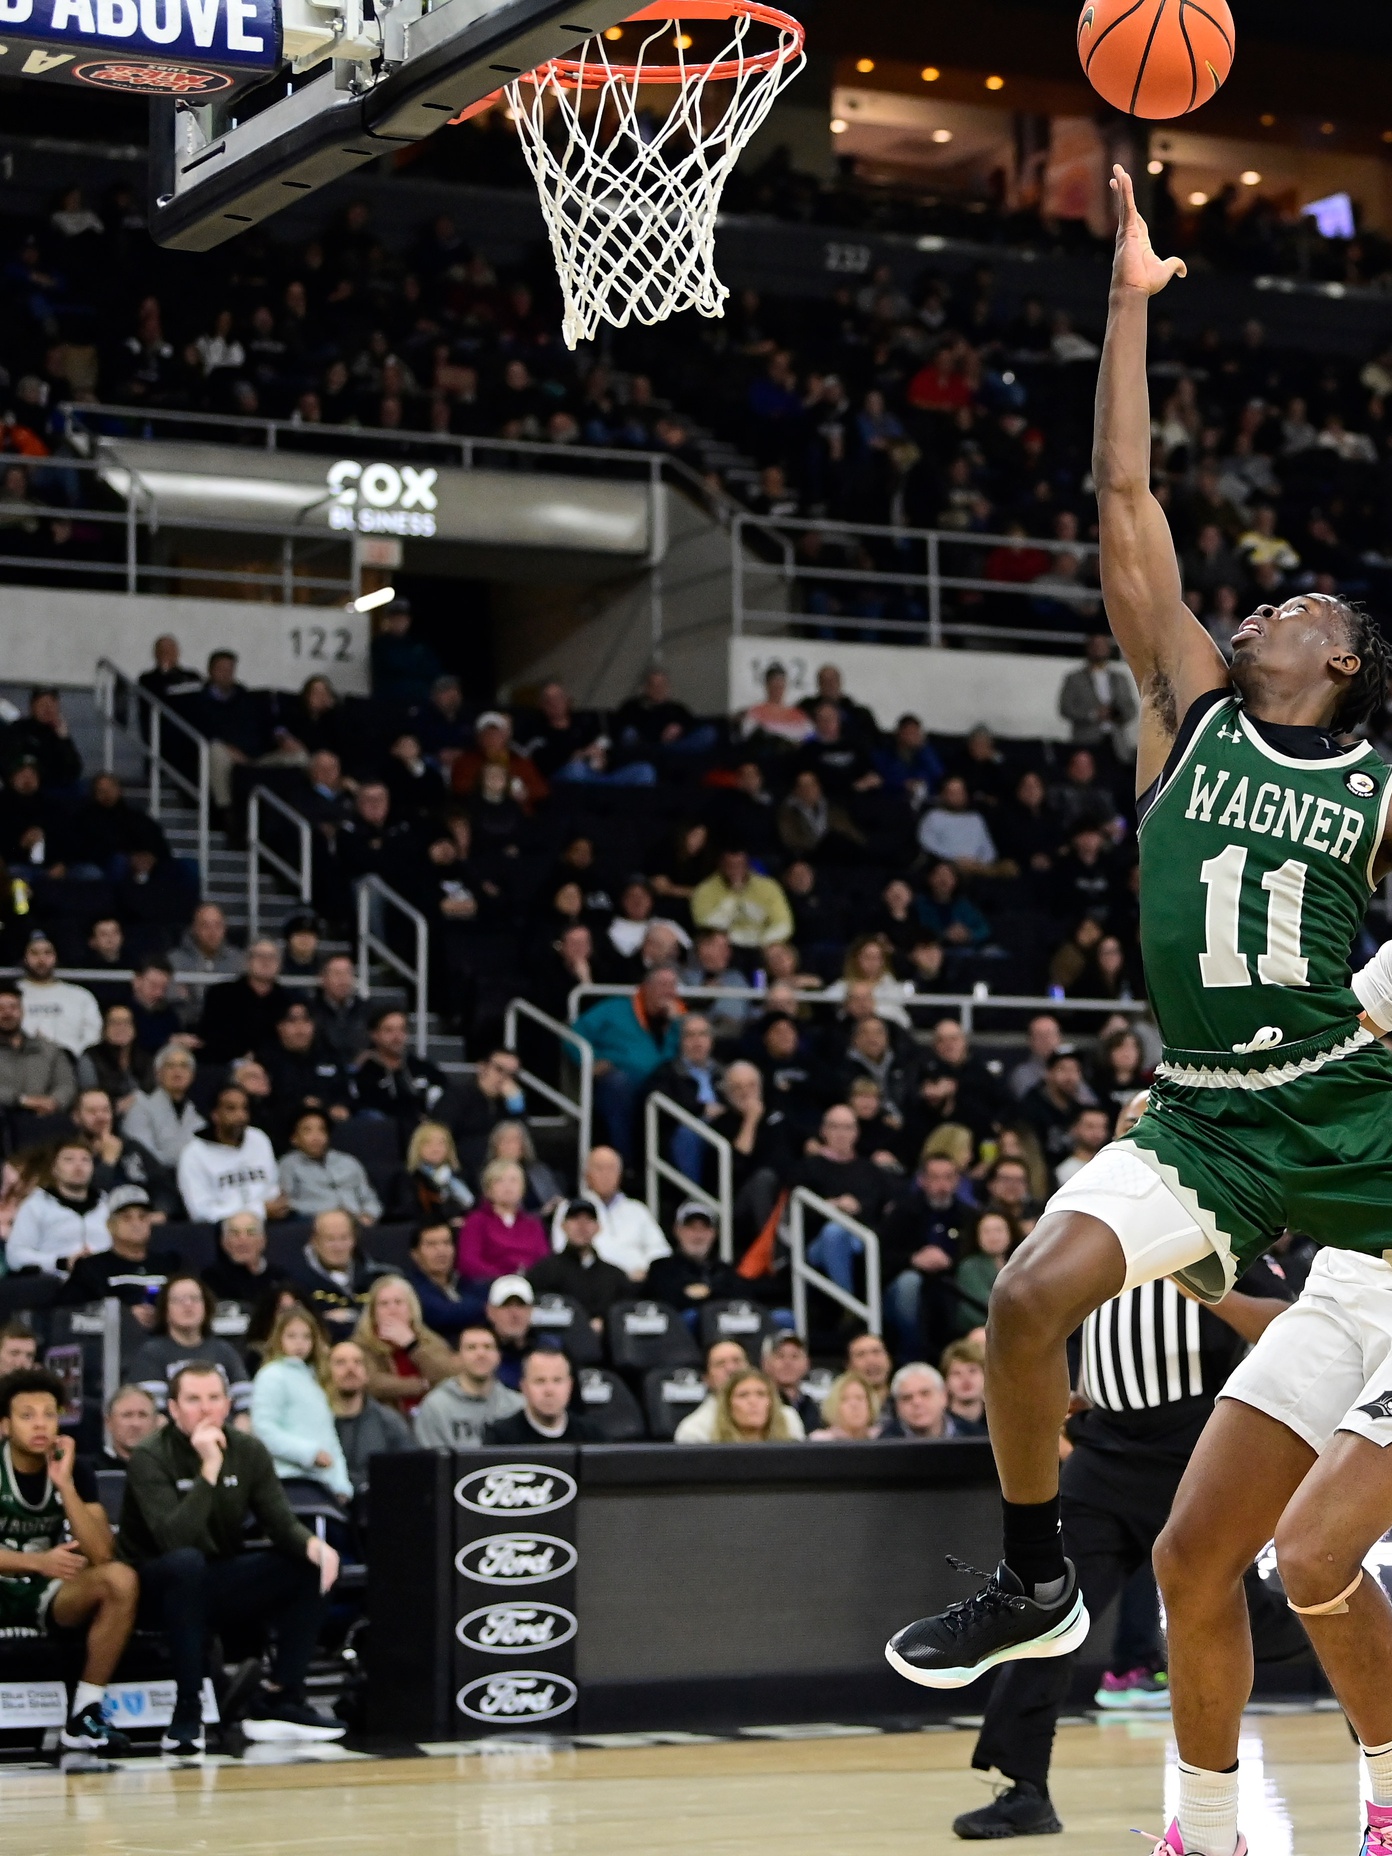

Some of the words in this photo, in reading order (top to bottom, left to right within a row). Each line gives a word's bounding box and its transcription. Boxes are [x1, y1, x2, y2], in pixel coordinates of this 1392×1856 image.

[52, 0, 264, 52] ABOVE
[327, 460, 438, 510] COX
[290, 626, 354, 662] 122
[751, 656, 808, 689] 12
[1185, 764, 1365, 864] WAGNER
[1199, 844, 1310, 988] 11
[477, 1471, 554, 1507] Ford
[478, 1539, 555, 1577] Ford
[479, 1608, 556, 1645] Ford
[480, 1677, 556, 1714] Ford
